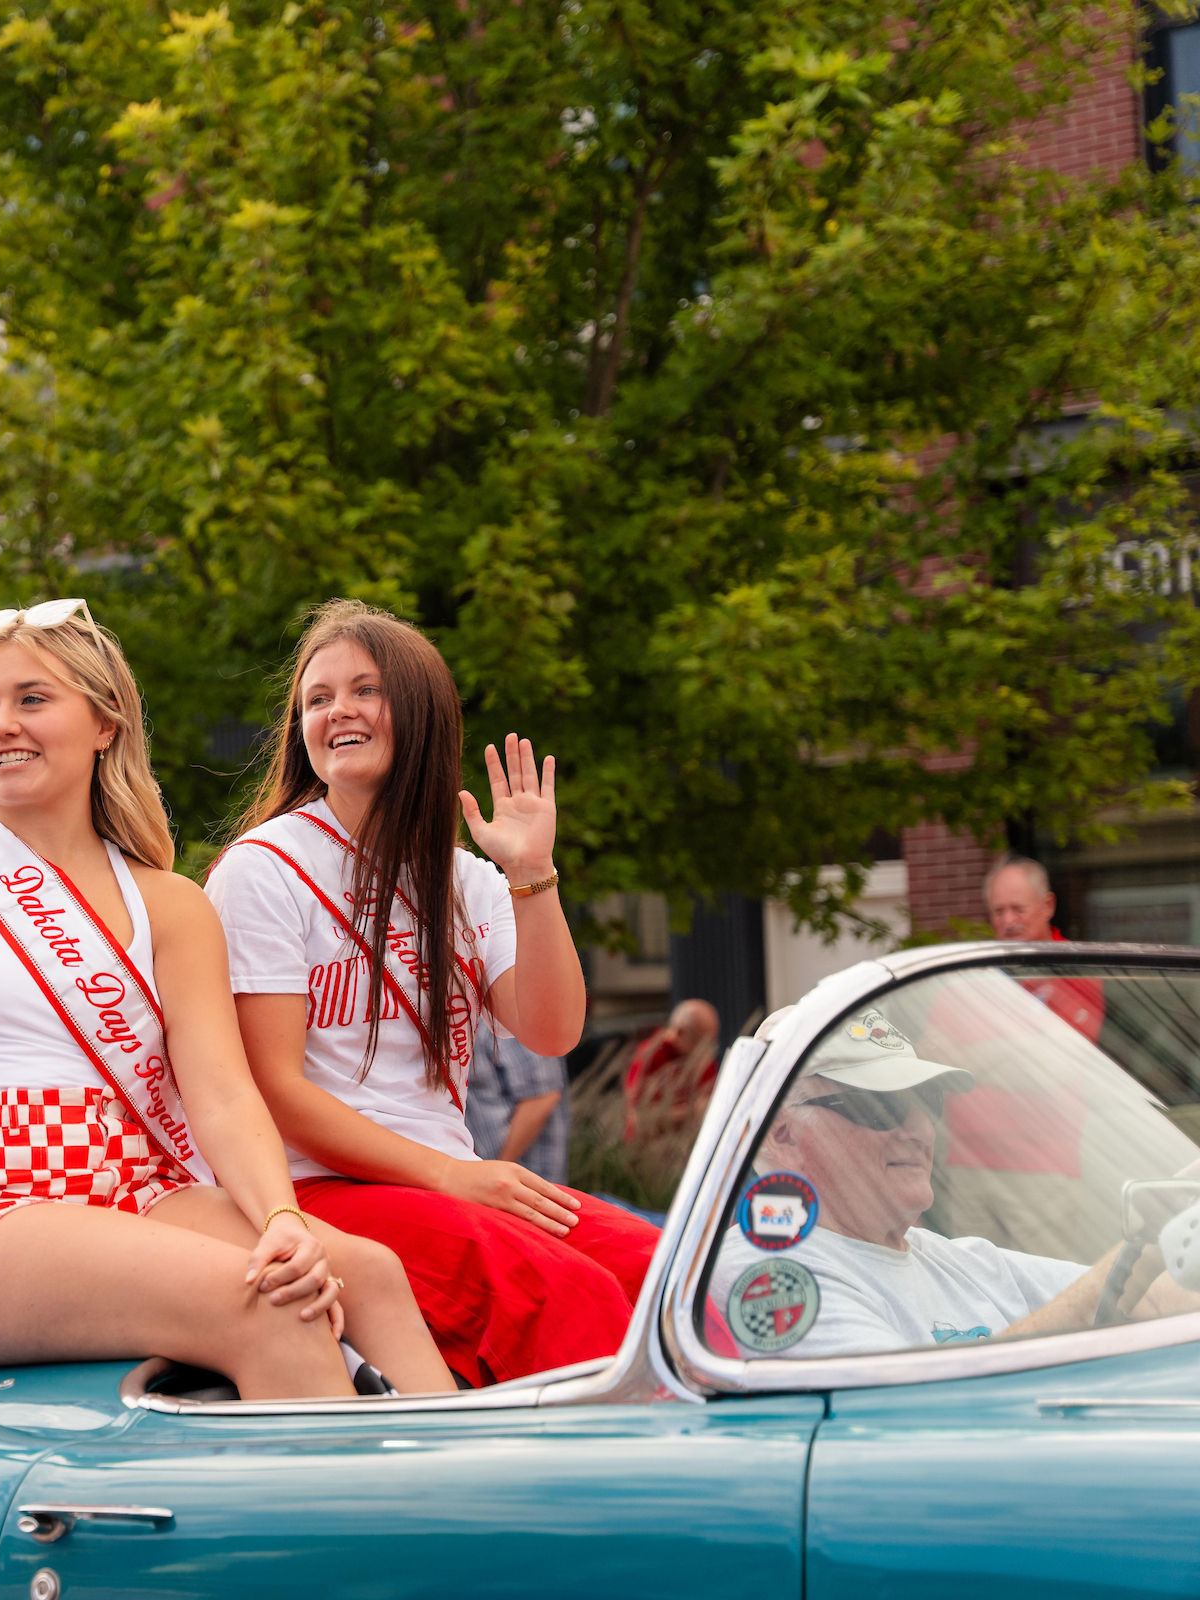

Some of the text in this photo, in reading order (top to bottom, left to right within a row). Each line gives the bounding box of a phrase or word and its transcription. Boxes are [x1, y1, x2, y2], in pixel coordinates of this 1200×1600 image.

[461, 922, 491, 944] OF
[0, 865, 195, 1162] Dakota Days Royalty
[752, 1330, 799, 1348] Museum
